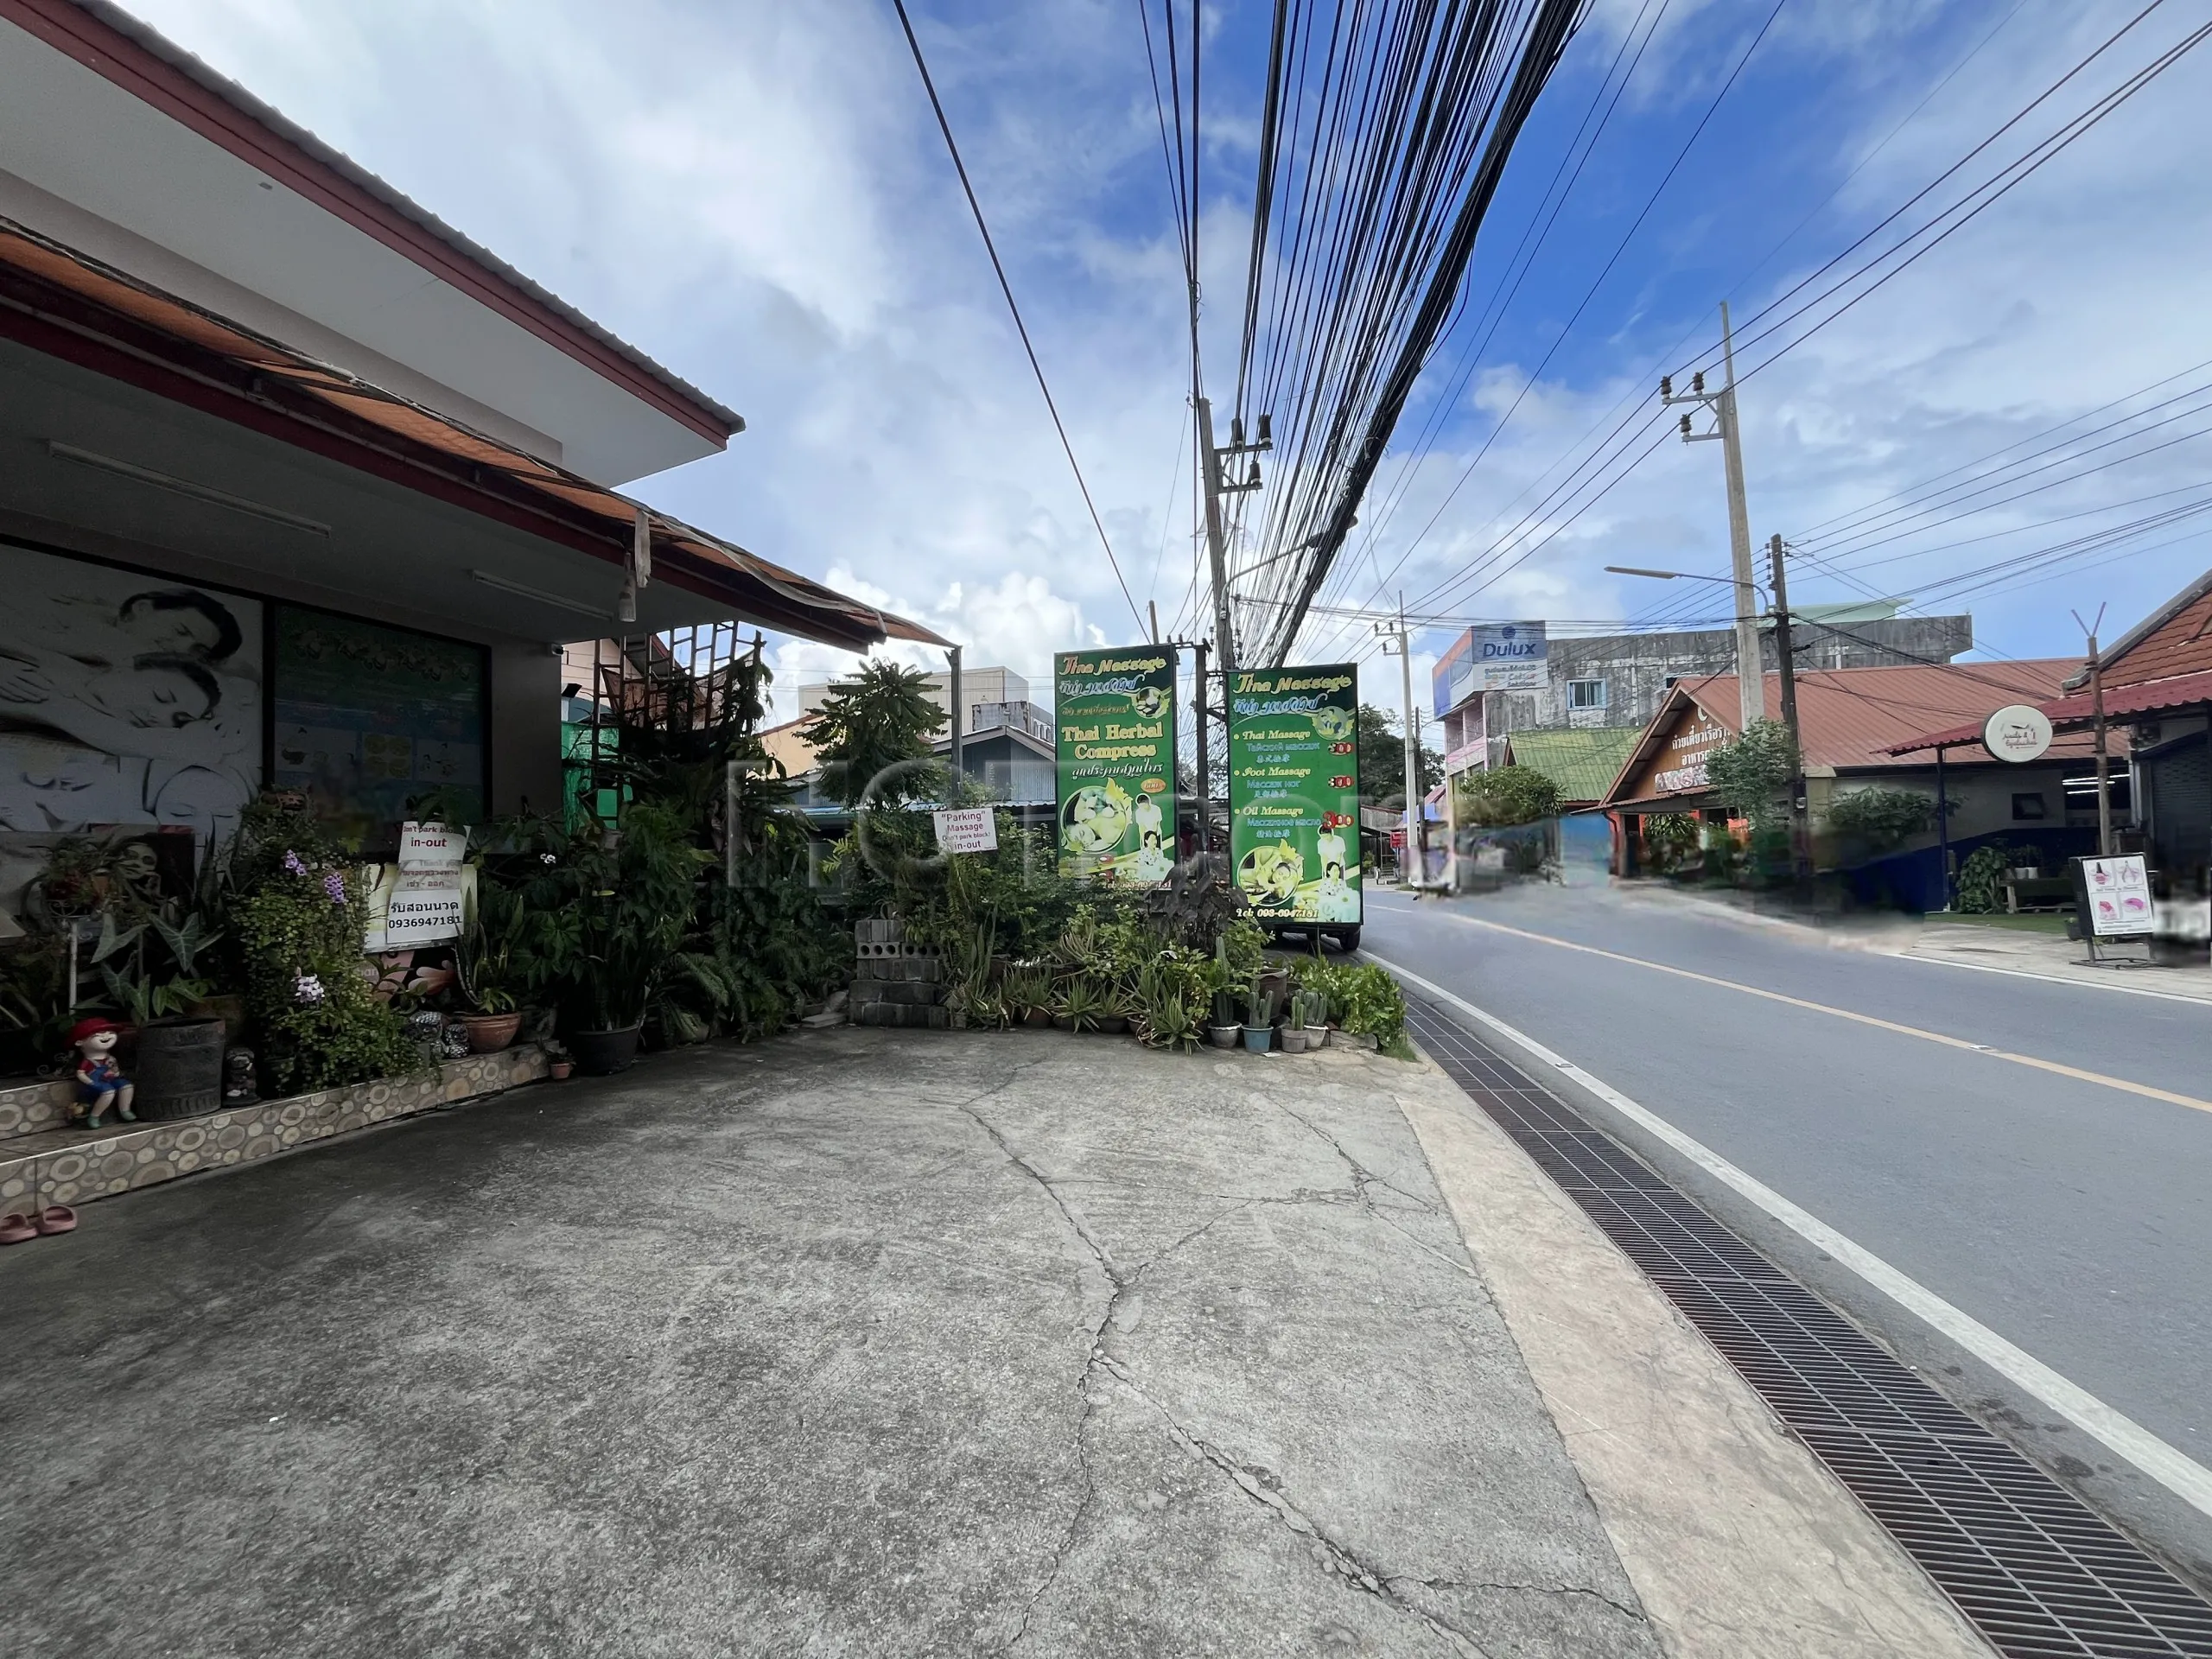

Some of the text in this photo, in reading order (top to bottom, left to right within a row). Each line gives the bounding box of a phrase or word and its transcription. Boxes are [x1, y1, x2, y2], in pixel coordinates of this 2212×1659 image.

[1483, 642, 1536, 657] Dulux
[1094, 656, 1166, 676] Massage
[1271, 674, 1352, 695] Massage
[1061, 721, 1163, 742] Thai Herbal
[1243, 730, 1311, 741] Thai Massage
[1074, 744, 1157, 761] Compress
[1243, 767, 1311, 778] Foot Massage
[1243, 806, 1303, 817] Oil Massage
[947, 823, 983, 831] Massage
[410, 837, 448, 847] in-out
[955, 840, 982, 849] in-out
[391, 901, 459, 913] รับสอนนวด
[388, 916, 462, 929] 0936947181
